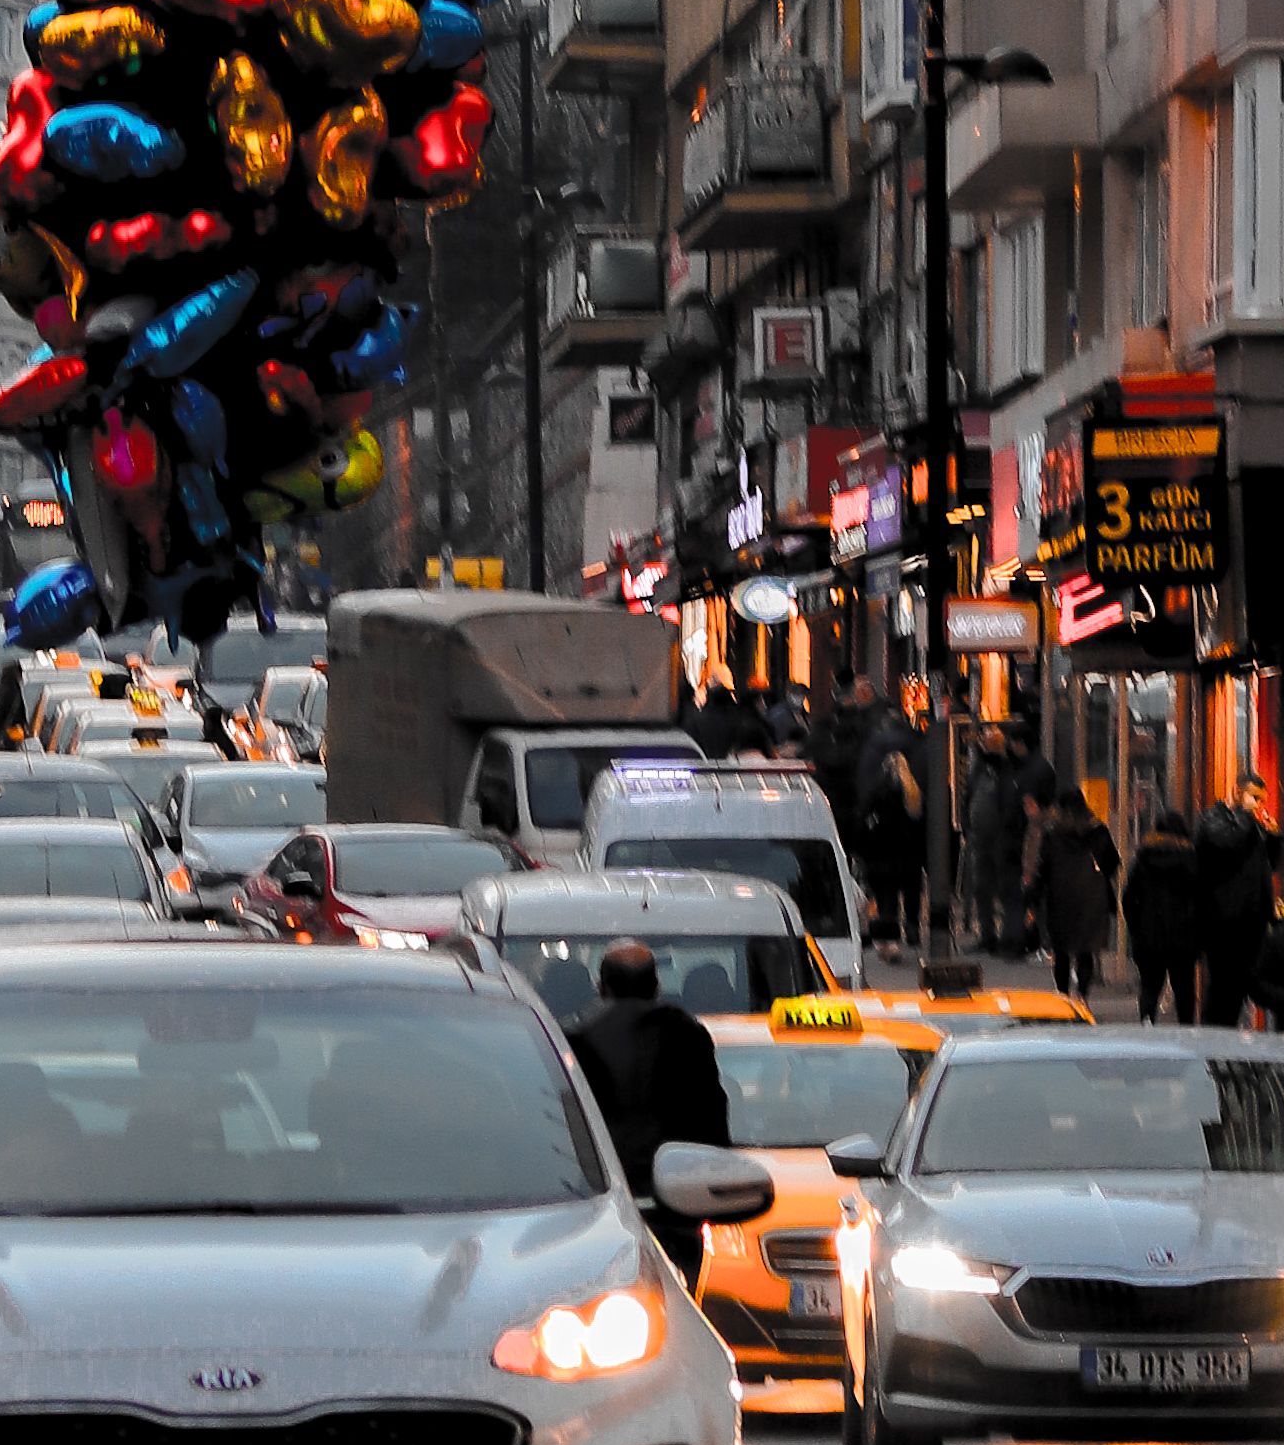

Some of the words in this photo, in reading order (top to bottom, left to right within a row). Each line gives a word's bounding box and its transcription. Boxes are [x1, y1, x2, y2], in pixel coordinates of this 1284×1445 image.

[773, 325, 805, 363] E
[1096, 480, 1132, 541] 3
[1150, 482, 1201, 508] GÜN
[1138, 510, 1212, 533] KALICI
[1096, 536, 1215, 574] PARFÜM
